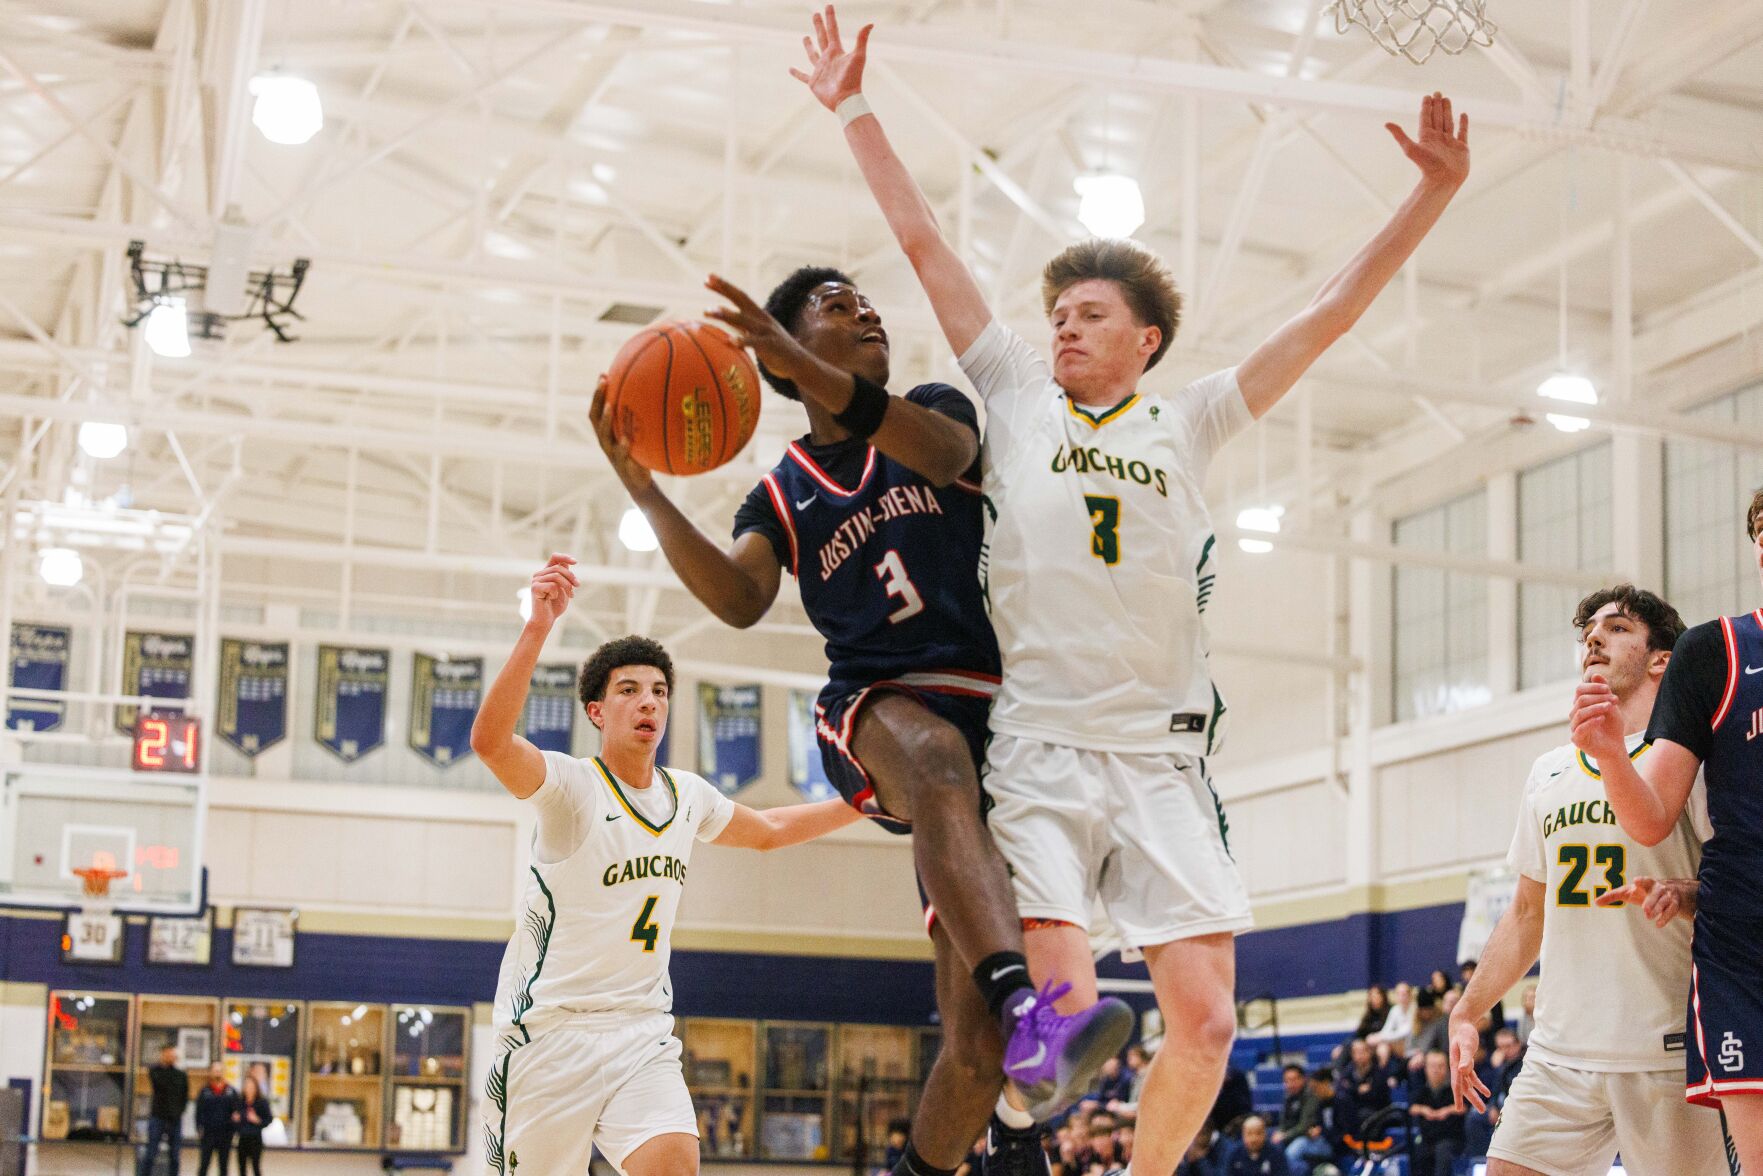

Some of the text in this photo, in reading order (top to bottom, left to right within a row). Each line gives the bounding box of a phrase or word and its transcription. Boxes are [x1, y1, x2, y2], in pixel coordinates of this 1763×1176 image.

[1083, 492, 1121, 567] 3
[873, 548, 926, 625] 3
[1746, 705, 1763, 742] J
[1543, 800, 1617, 839] GAUCH
[602, 855, 687, 887] GAUCHOS
[1556, 844, 1627, 908] 23
[81, 922, 107, 946] 30
[630, 895, 661, 953] 4
